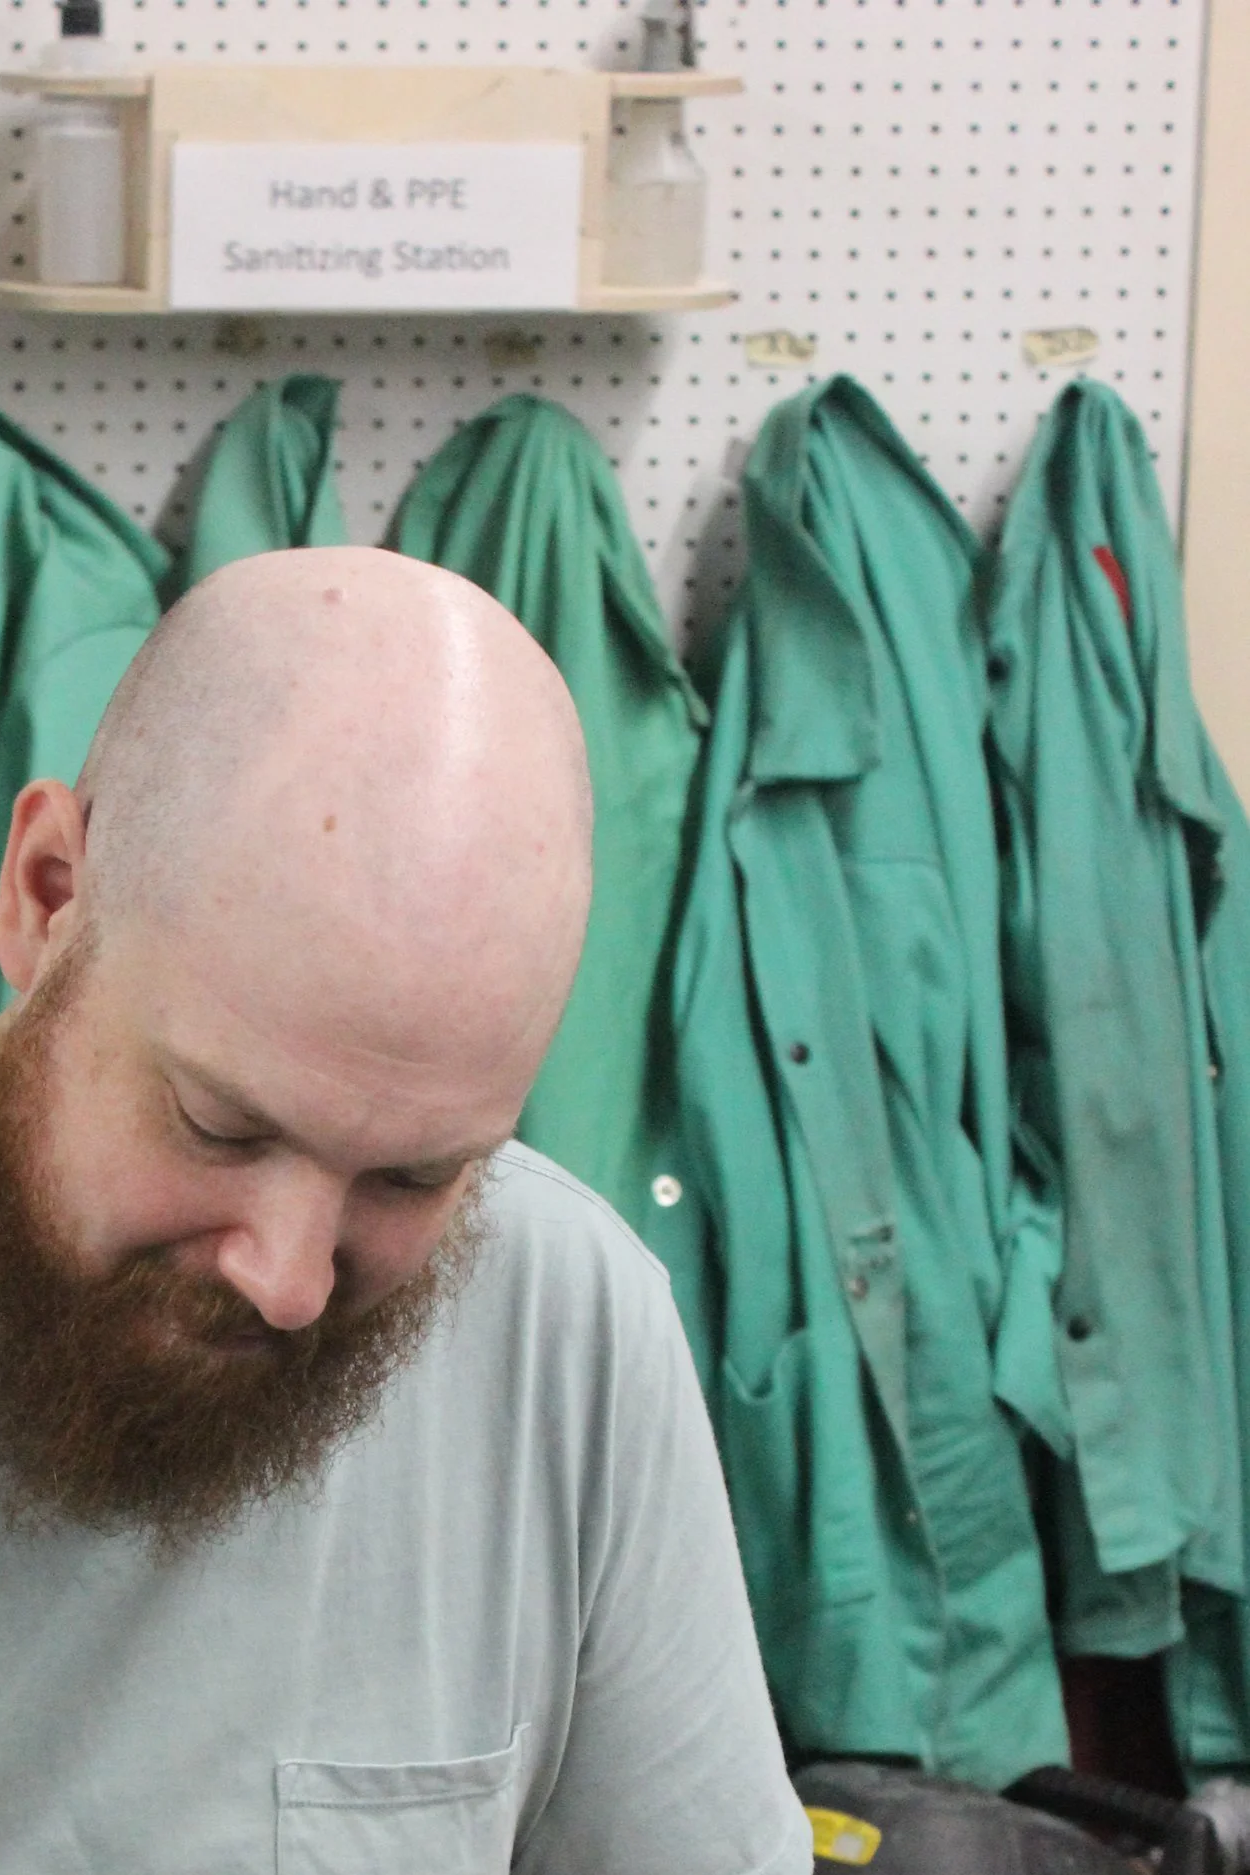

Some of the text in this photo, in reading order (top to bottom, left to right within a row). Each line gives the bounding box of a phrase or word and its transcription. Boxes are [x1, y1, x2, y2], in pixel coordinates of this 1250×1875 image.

[269, 177, 466, 209] Hand & PPE
[223, 240, 510, 278] Sanitizing Station
